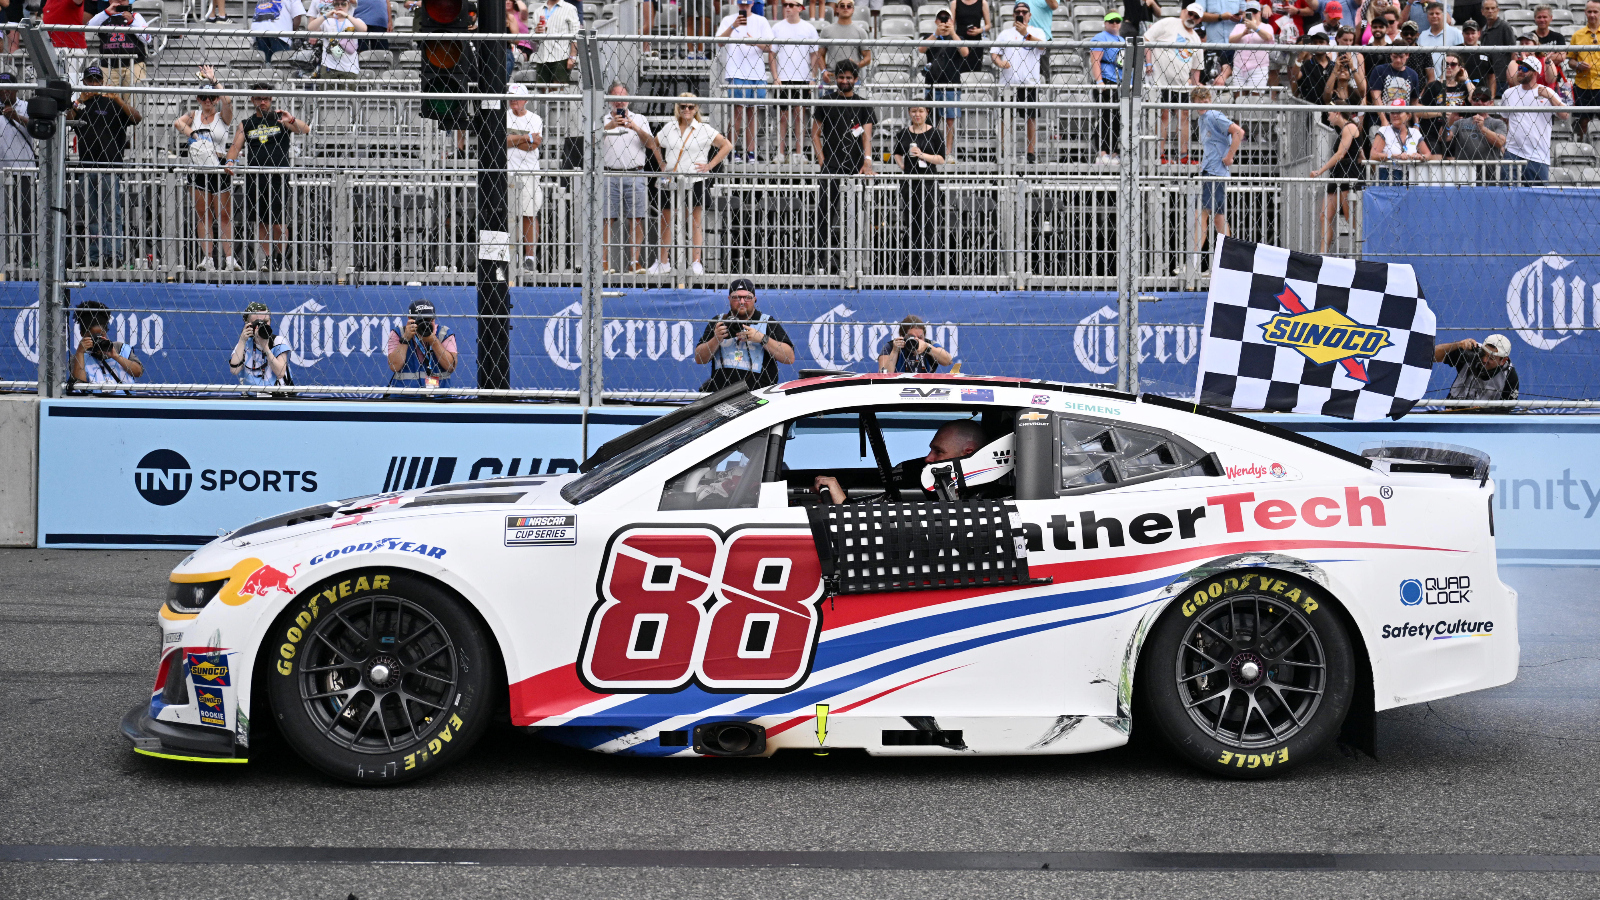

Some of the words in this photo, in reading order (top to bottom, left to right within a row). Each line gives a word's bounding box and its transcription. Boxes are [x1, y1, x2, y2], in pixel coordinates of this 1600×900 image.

[110, 32, 126, 42] 23
[1506, 251, 1600, 351] Cu
[14, 300, 164, 364] Cvo
[278, 298, 403, 368] Cuerv
[1268, 318, 1385, 353] SUNOCO
[1065, 401, 1121, 416] SIEMENS
[135, 467, 193, 491] TNT
[200, 468, 318, 493] SPORTS
[1225, 463, 1268, 480] Wendy's
[1488, 465, 1600, 519] inity
[527, 516, 567, 527] NASCAR
[515, 530, 534, 539] CUP
[534, 529, 567, 539] SERIES
[309, 536, 447, 566] GOODYEAR
[1424, 575, 1471, 591] QUAD
[1181, 573, 1319, 618] GOODYEAR
[1425, 590, 1471, 605] LOCK
[578, 524, 825, 694] 88
[276, 574, 391, 676] GOODYEAR
[1381, 618, 1494, 641] SafetyCulture
[192, 666, 227, 676] SUNOCO
[199, 695, 221, 704] SUNOCO
[200, 710, 225, 720] ROOKIE
[403, 712, 464, 771] EAGLE
[1217, 746, 1289, 769] EAGLE
